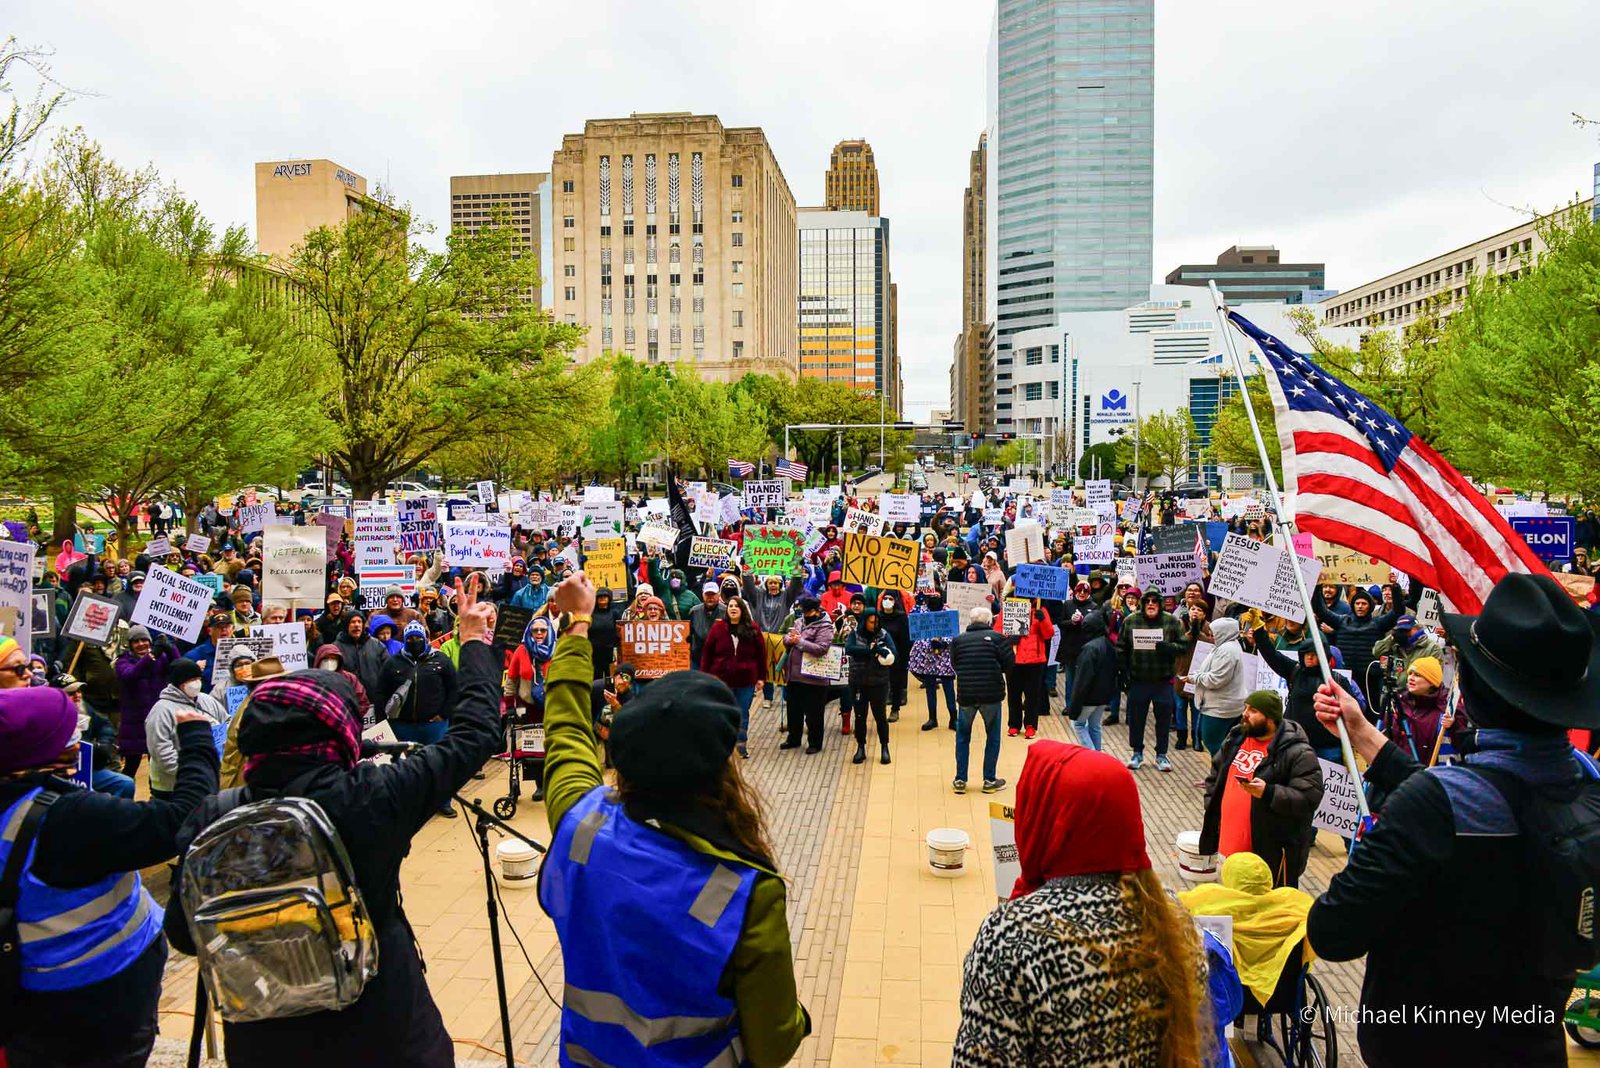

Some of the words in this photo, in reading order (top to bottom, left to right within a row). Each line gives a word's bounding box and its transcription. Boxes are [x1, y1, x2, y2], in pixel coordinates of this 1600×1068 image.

[273, 164, 312, 180] ARVEST
[335, 169, 356, 188] ARVEST
[748, 485, 780, 493] HANDS
[752, 494, 778, 503] OFF!
[241, 503, 268, 518] HANDS
[398, 512, 415, 521] LET
[401, 520, 436, 532] DESTROY
[852, 511, 880, 528] HANDS
[401, 532, 438, 551] DEMOCRACY
[849, 534, 880, 556] NO
[1227, 535, 1260, 551] JESUS
[1526, 534, 1566, 544] ELON
[451, 544, 472, 560] Right
[692, 543, 728, 555] CHECKS
[753, 547, 791, 556] HANDS
[1225, 547, 1239, 555] Love
[690, 557, 730, 569] BALANCES
[1220, 558, 1248, 572] Empathy
[1222, 552, 1258, 566] Compassion
[845, 553, 915, 589] KINGS
[1219, 564, 1247, 577] Welcome
[152, 569, 176, 588] SOCIAL
[178, 580, 210, 599] SECURITY
[1214, 578, 1240, 590] Charity
[1217, 571, 1244, 585] Kindness
[361, 587, 386, 597] DEFEND
[1016, 588, 1036, 596] PAYING
[1213, 584, 1235, 597] Mercy
[1270, 585, 1291, 596] Spite
[159, 587, 167, 598] IS
[170, 591, 186, 605] NOT
[187, 600, 199, 610] AN
[361, 596, 414, 608] DEMOCY
[150, 600, 193, 622] ENTITLEMENT
[1265, 600, 1296, 616] Cruelty
[1425, 611, 1439, 620] EXT
[148, 614, 188, 636] PROGRAM!
[253, 629, 299, 644] MKE
[625, 623, 685, 643] HANDS
[635, 642, 671, 654] OFF
[280, 652, 307, 663] CRACY
[1324, 778, 1357, 799] erning
[1330, 798, 1356, 812] ents
[1314, 811, 1356, 831] OSCOW
[1020, 951, 1085, 999] APRES
